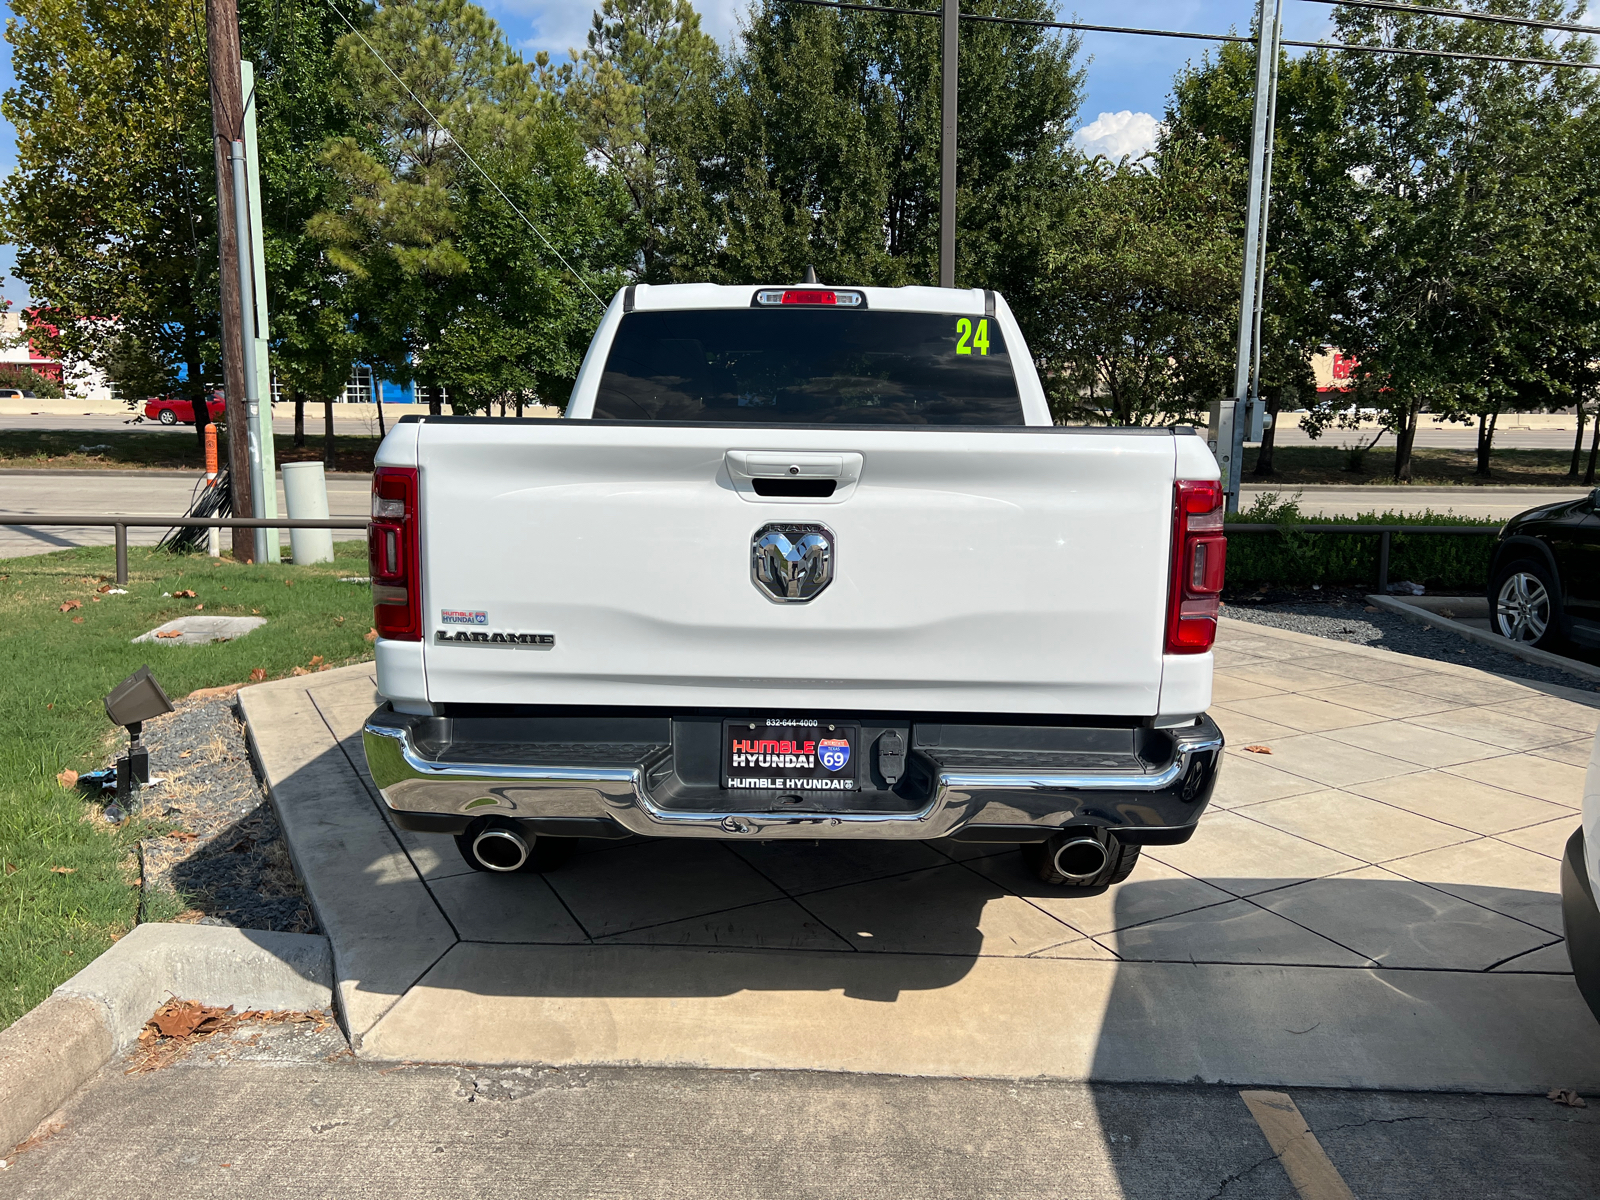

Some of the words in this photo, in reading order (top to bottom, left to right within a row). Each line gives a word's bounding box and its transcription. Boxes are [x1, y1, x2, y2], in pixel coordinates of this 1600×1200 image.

[956, 318, 990, 356] 24
[769, 524, 820, 532] RAM
[434, 630, 555, 646] LARAMIE
[766, 719, 818, 727] 832-644-4000
[732, 739, 815, 754] HUMBLE
[732, 754, 815, 768] HYUNDAI
[823, 752, 844, 766] 69
[728, 778, 784, 788] HUMBLE
[786, 779, 844, 789] HYUNDAI
